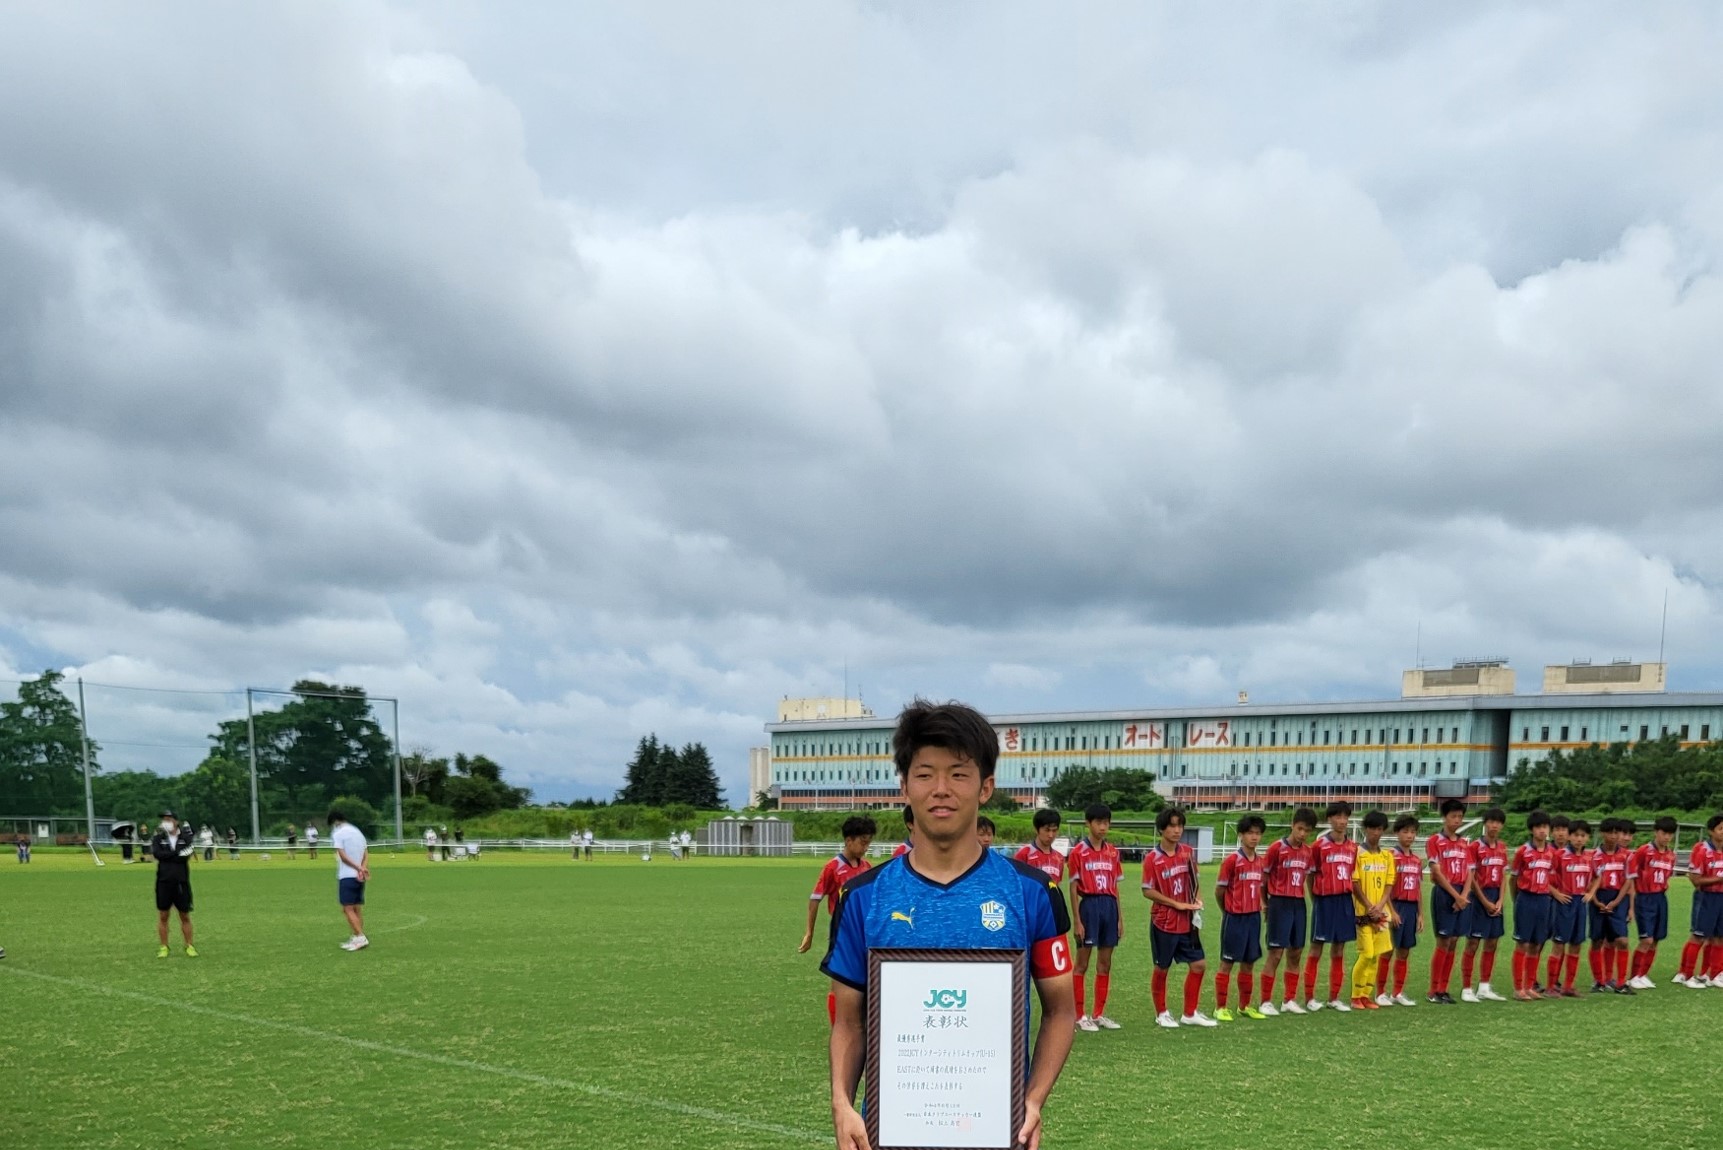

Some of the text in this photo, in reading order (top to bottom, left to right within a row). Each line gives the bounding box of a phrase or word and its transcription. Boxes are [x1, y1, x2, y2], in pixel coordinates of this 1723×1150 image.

[1189, 722, 1229, 746] レース
[1373, 876, 1382, 889] 16
[1051, 939, 1067, 972] C
[923, 990, 967, 1008] JCY
[922, 1014, 969, 1029] 表彰状
